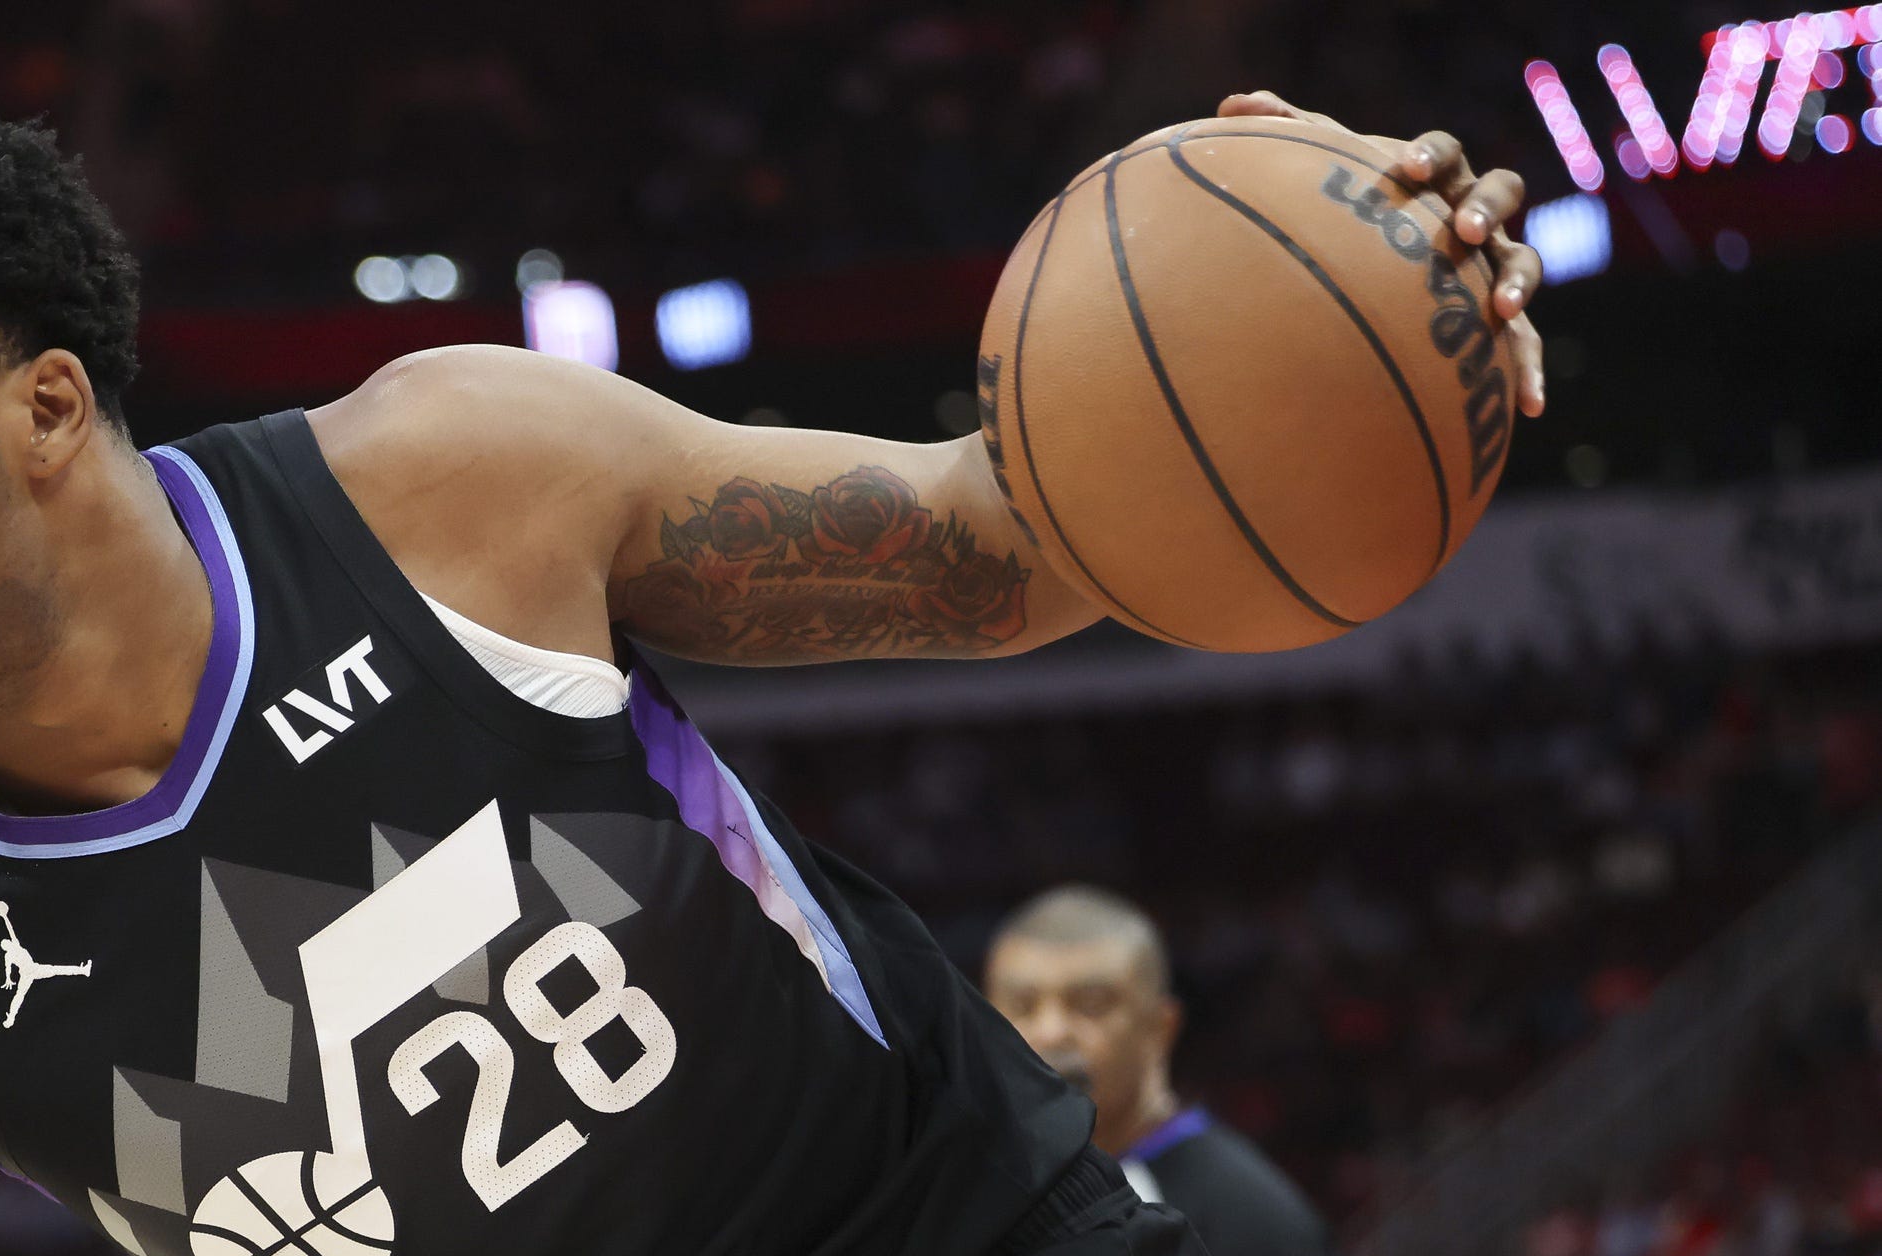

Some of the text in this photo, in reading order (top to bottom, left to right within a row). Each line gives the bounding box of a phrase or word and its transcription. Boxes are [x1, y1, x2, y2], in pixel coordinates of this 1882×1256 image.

[1322, 164, 1507, 497] Wilson
[262, 635, 392, 764] LVT
[388, 921, 676, 1212] 28
